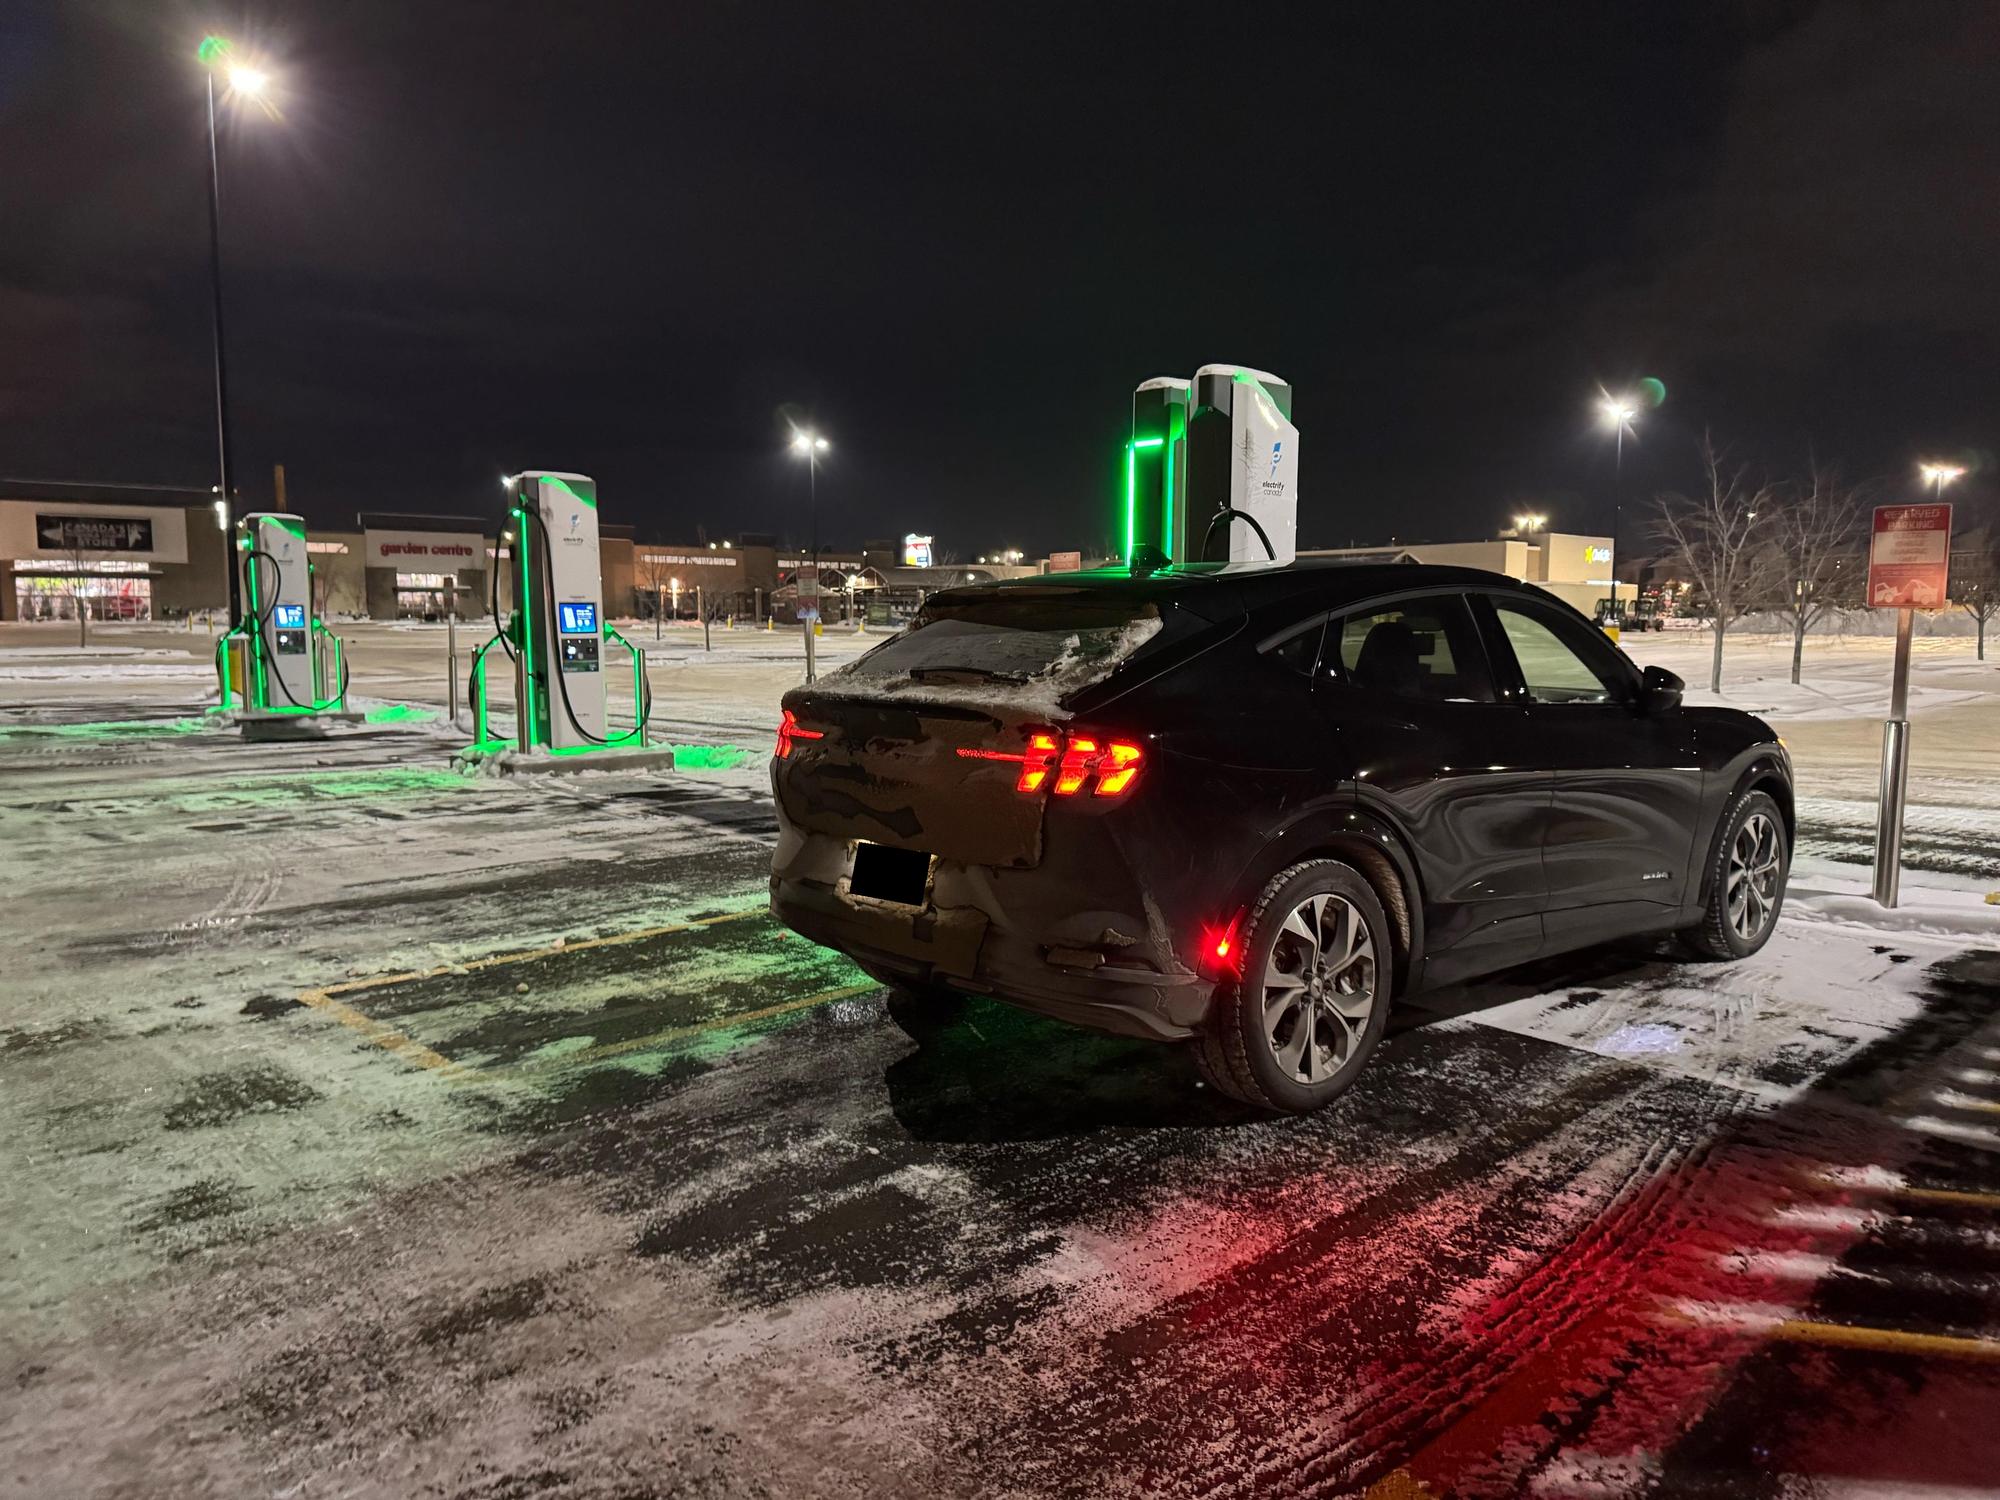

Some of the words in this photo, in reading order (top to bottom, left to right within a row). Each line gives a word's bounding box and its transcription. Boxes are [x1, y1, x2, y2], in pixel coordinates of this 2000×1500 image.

[1262, 481, 1284, 491] electrify
[1884, 509, 1941, 519] RESERVED
[1888, 520, 1935, 530] PARKING
[380, 542, 428, 557] garden
[431, 544, 473, 556] centre
